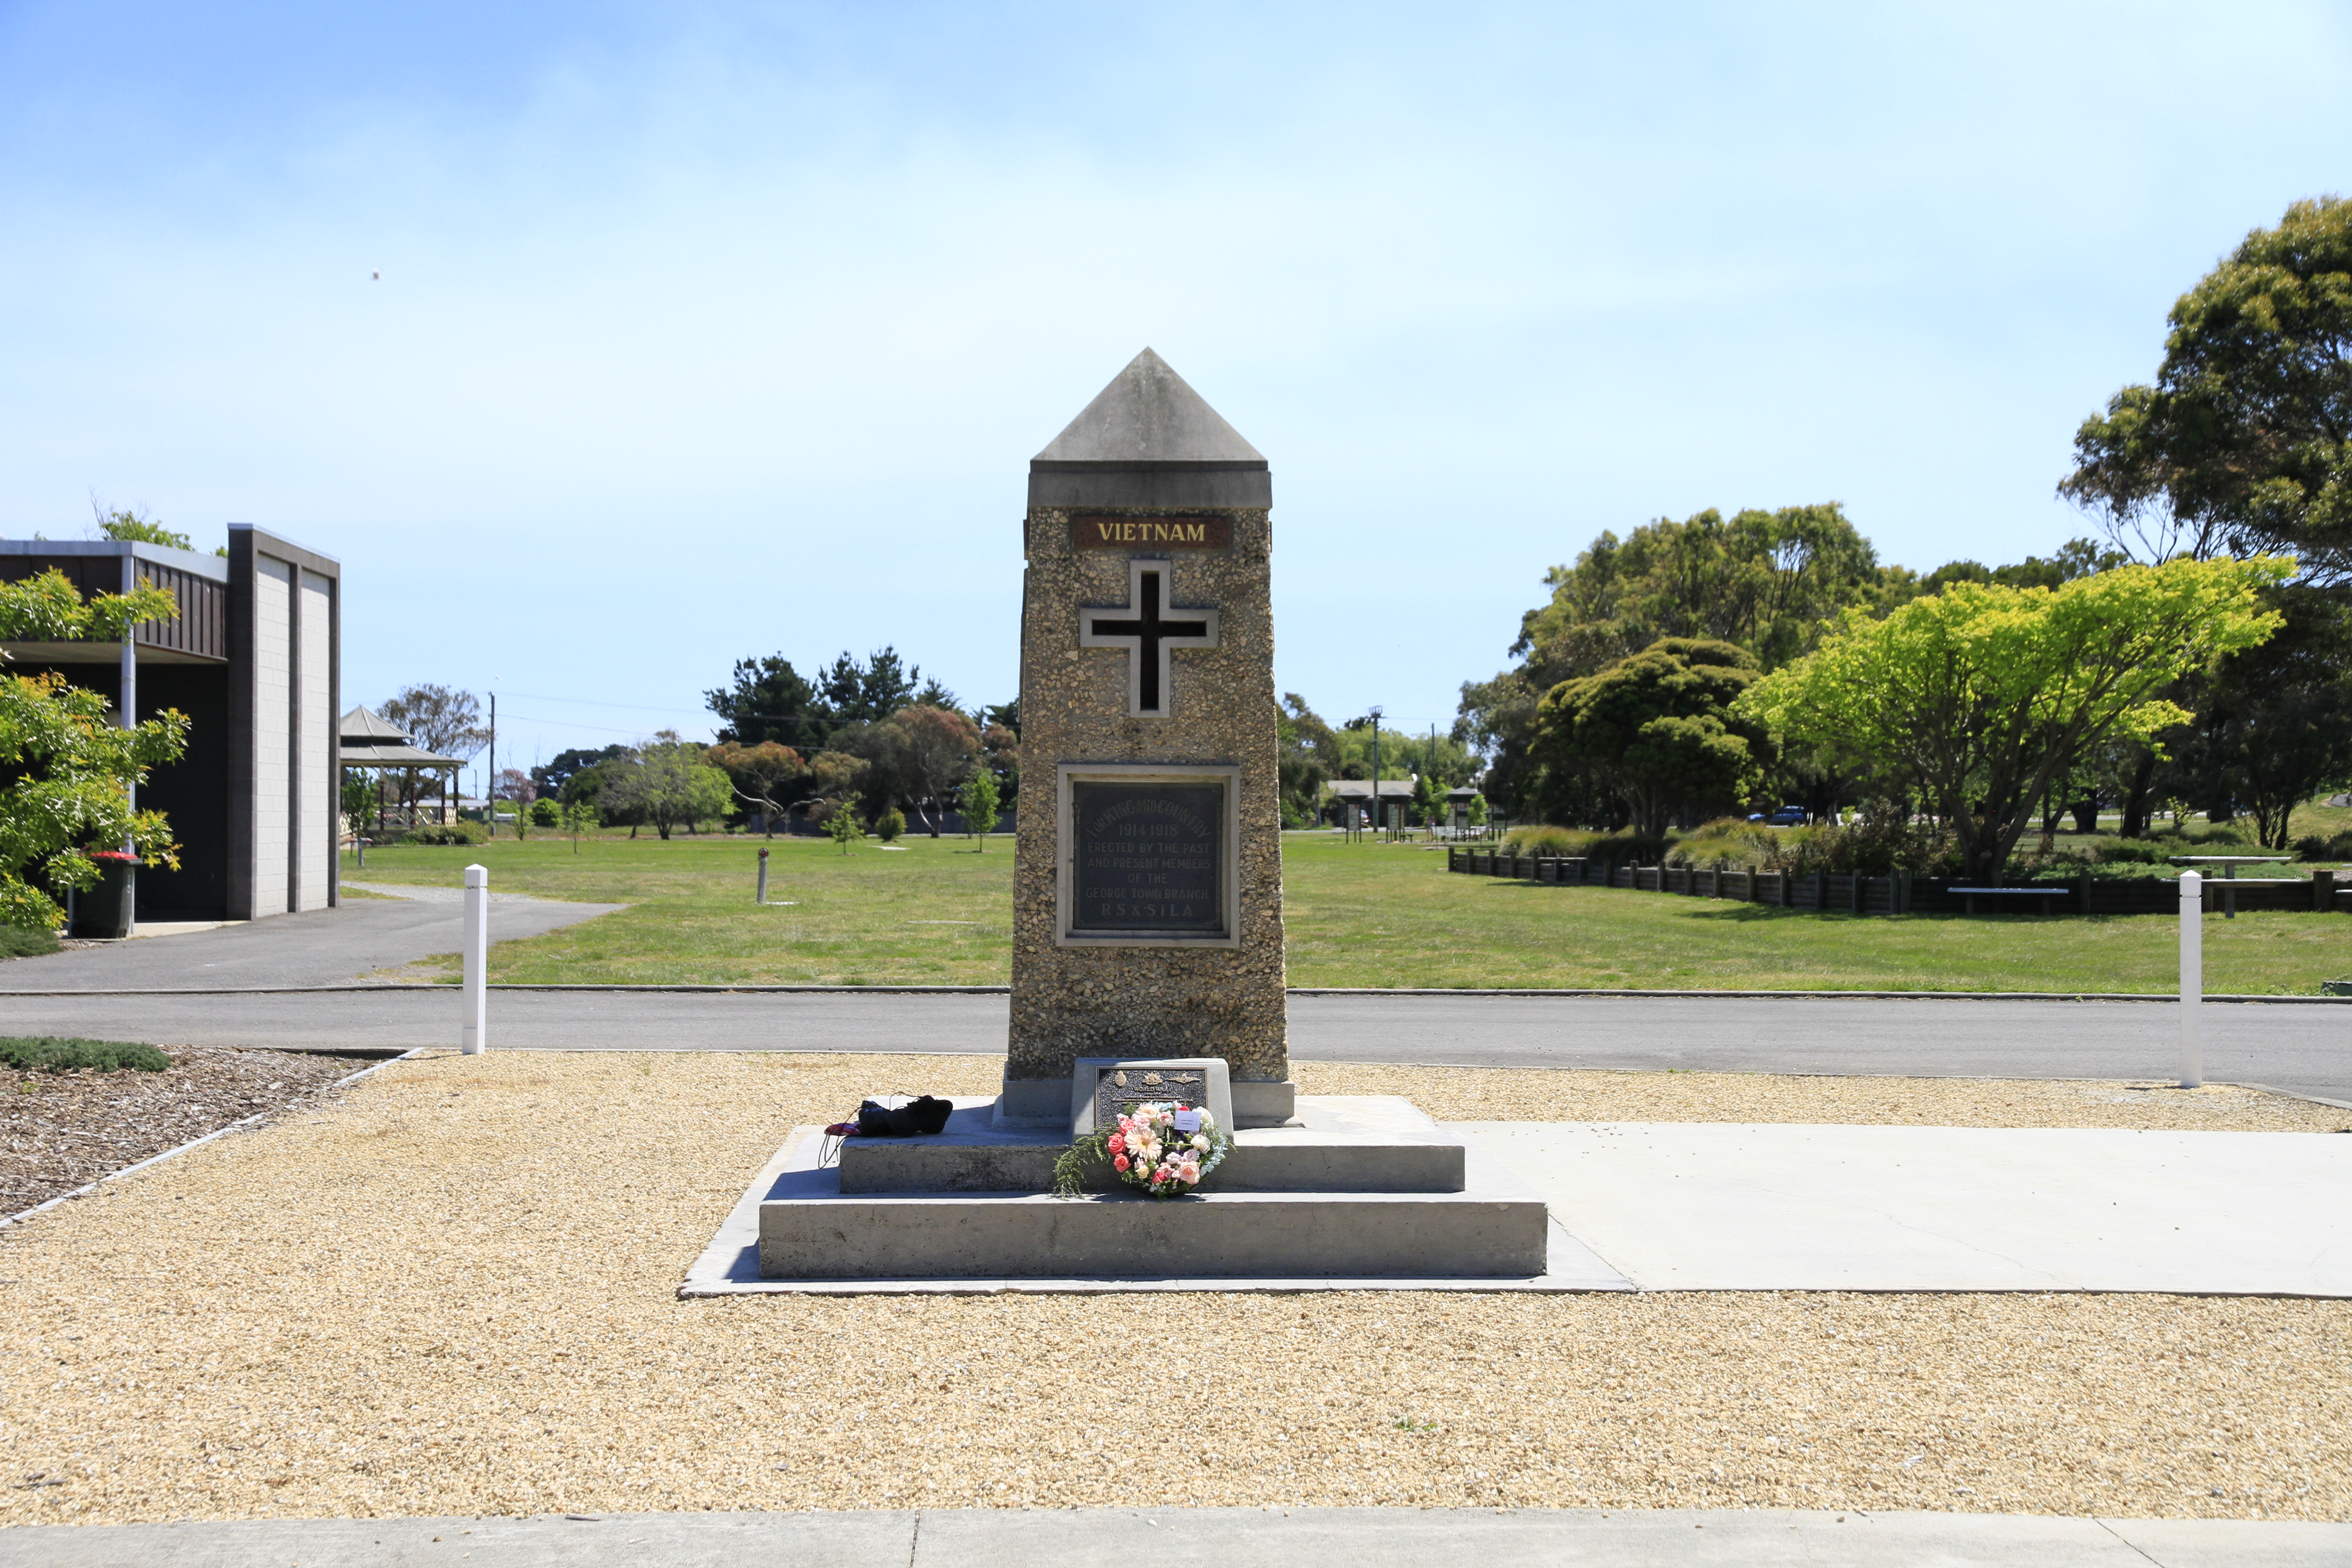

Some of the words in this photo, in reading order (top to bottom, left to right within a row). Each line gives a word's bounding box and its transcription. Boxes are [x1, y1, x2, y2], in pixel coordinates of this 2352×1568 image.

[1098, 523, 1205, 541] VIETNAM
[1086, 813, 1108, 838] FOR
[1102, 799, 1136, 824] KING
[1137, 800, 1157, 813] AND
[1157, 799, 1212, 838] COUNTRY
[1088, 842, 1134, 853] ERECTED
[1140, 843, 1154, 853] BY
[1158, 843, 1178, 853] THE
[1183, 843, 1210, 853] PAST
[1087, 858, 1109, 868] AND
[1113, 858, 1159, 868] PRESENT
[1162, 858, 1211, 869] MEMBERS
[1127, 873, 1141, 883] OF
[1147, 873, 1167, 883] THE
[1086, 888, 1127, 898] GEORGE
[1131, 888, 1162, 898] TOWN
[1164, 888, 1208, 899] BRANCH
